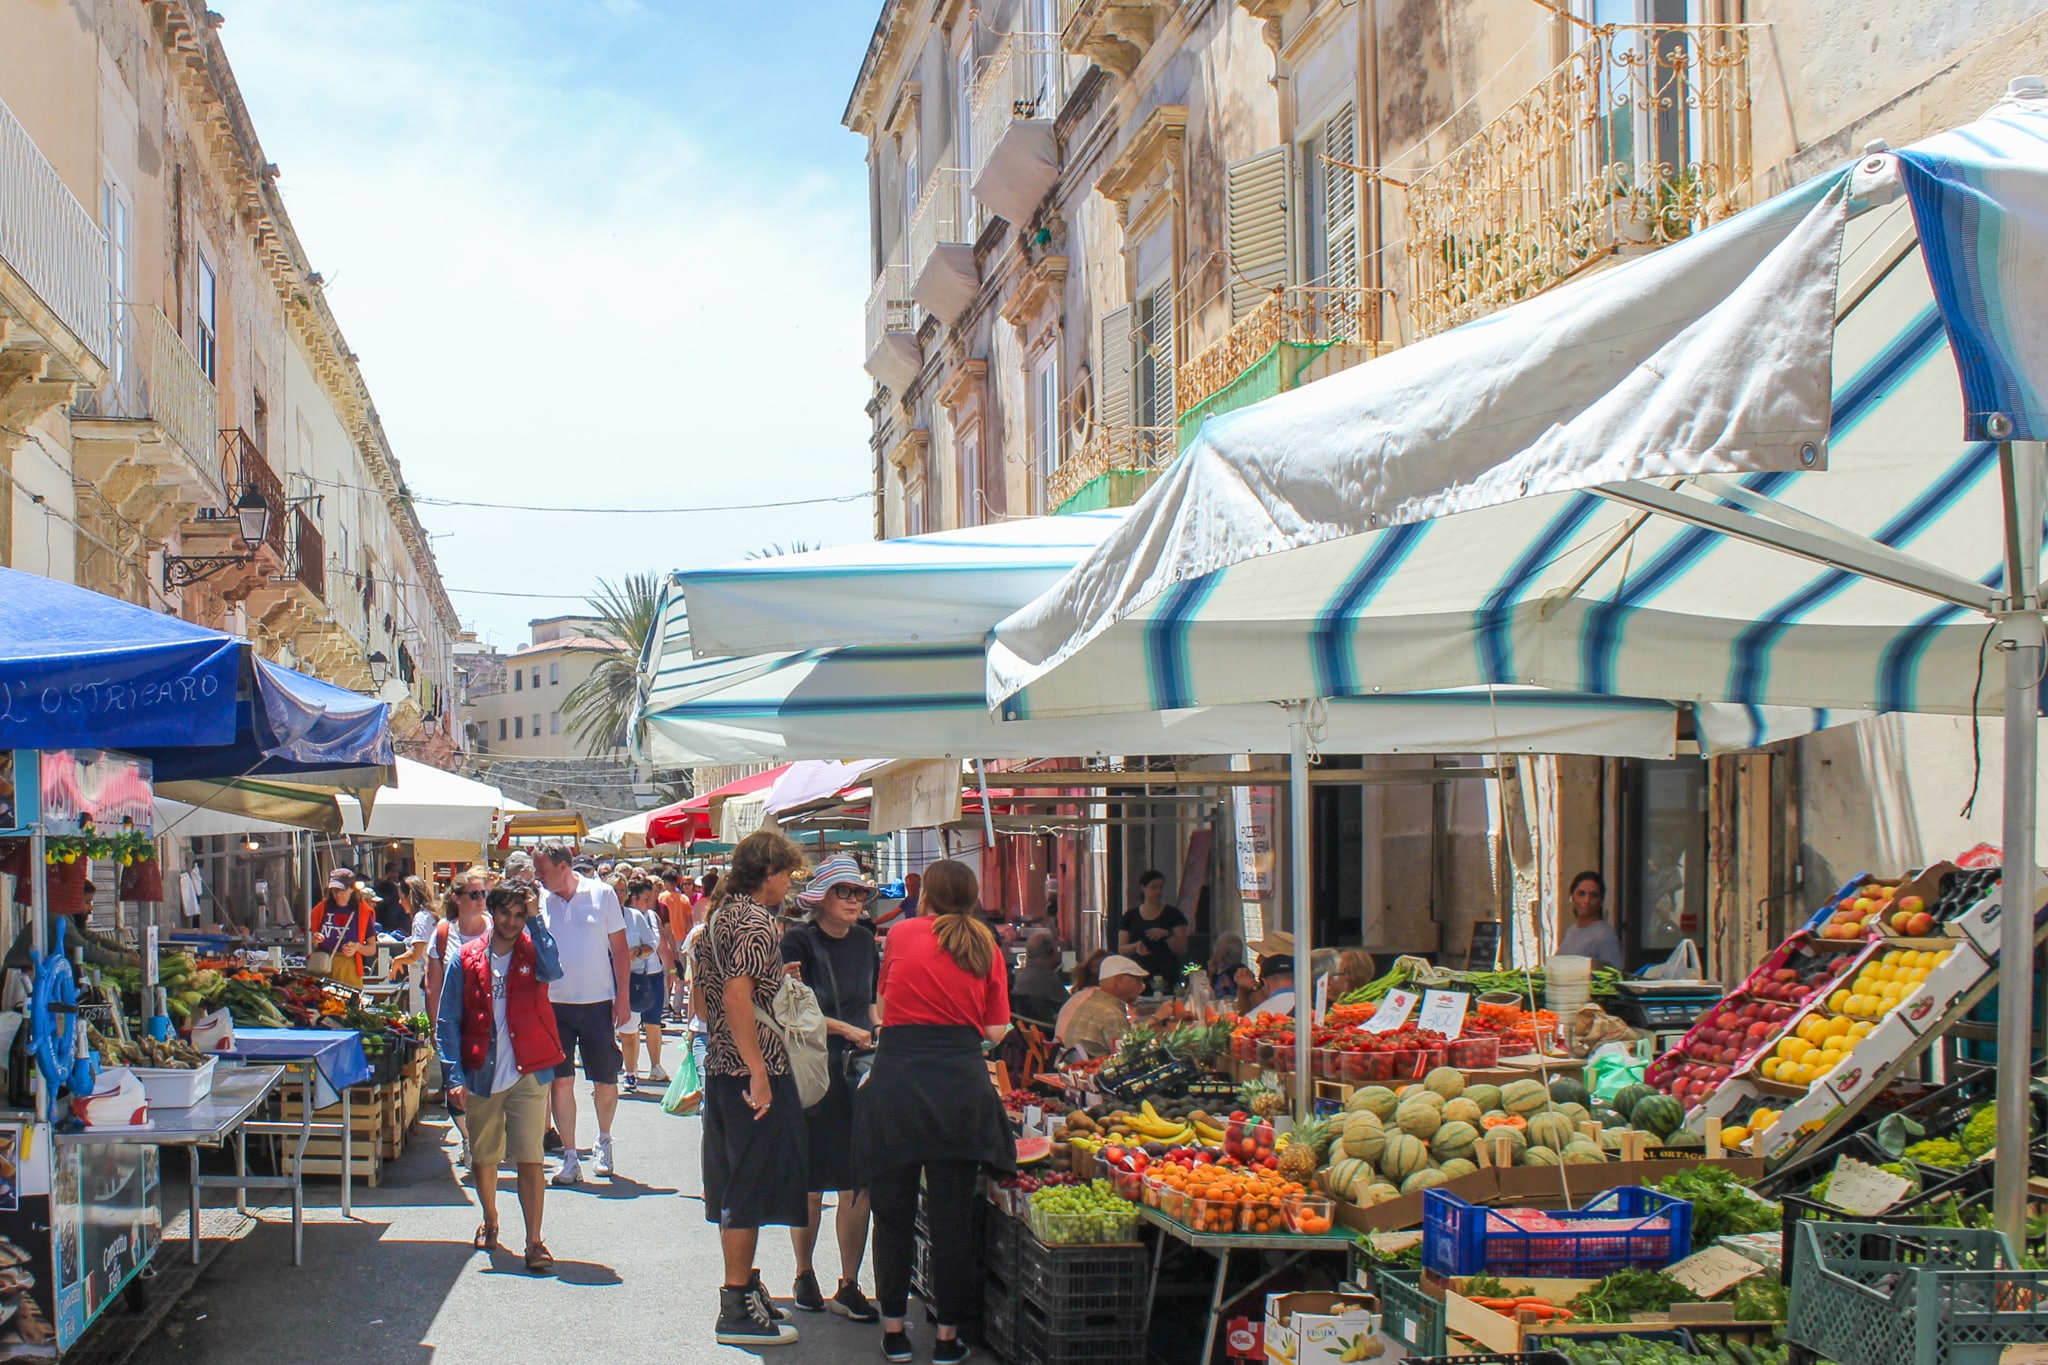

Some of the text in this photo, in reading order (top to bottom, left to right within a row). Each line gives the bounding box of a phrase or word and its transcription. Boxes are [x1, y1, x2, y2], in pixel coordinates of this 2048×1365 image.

[1241, 826, 1266, 838] PIZZERIA
[321, 925, 350, 939] NY
[1660, 1151, 1707, 1160] ORTAGG
